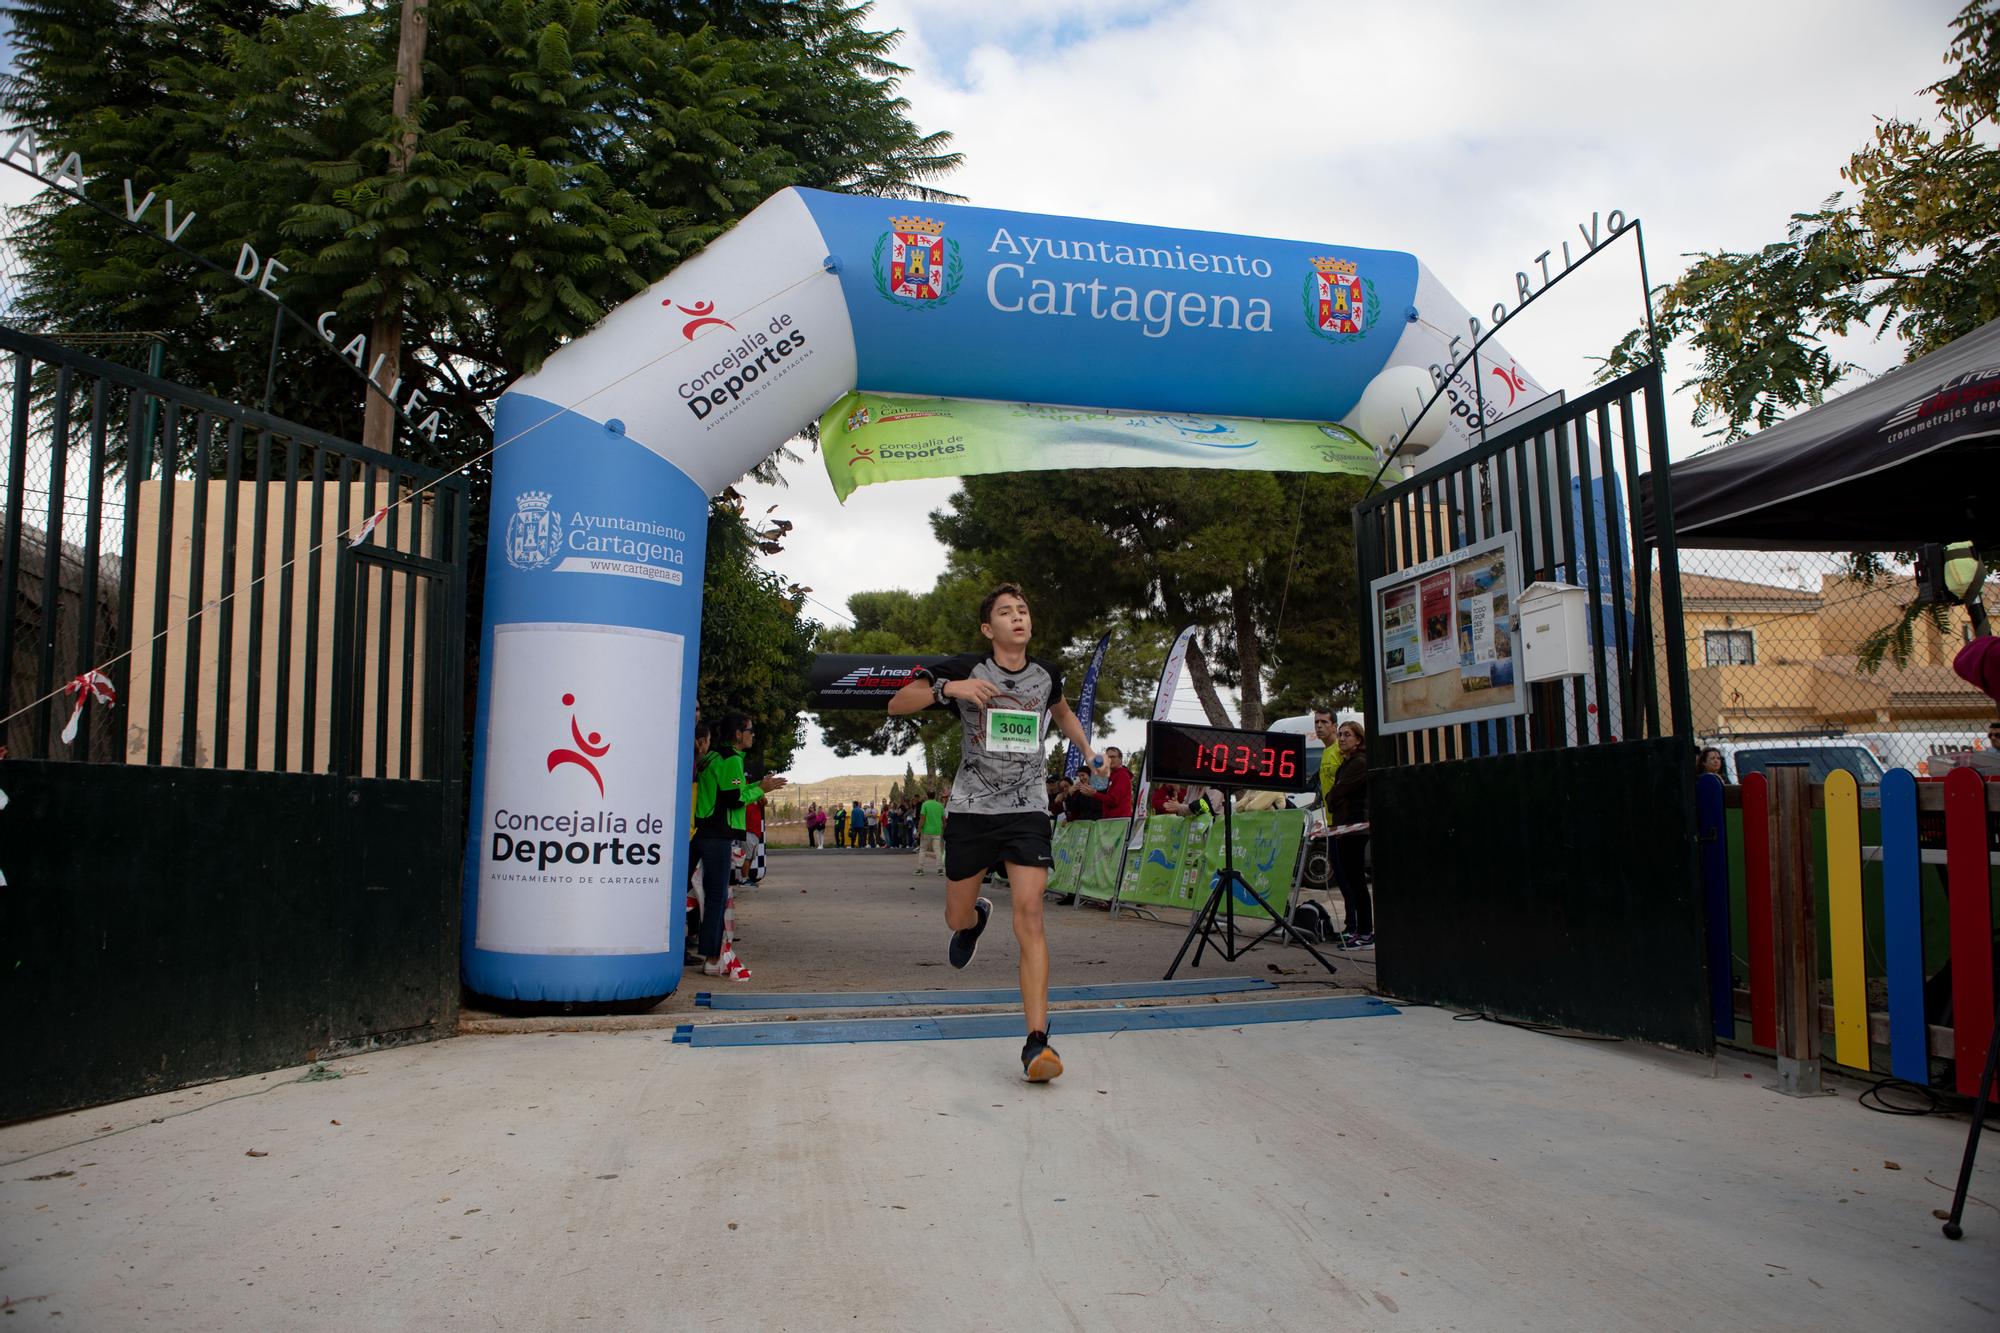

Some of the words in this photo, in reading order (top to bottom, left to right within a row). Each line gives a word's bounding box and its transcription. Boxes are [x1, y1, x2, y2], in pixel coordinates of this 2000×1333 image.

[987, 228, 1273, 278] Ayuntamiento
[987, 263, 1273, 338] Cartagena
[234, 243, 289, 300] DE
[317, 311, 441, 443] GALIFA
[678, 331, 768, 399] Concejalía
[769, 314, 793, 334] de
[687, 329, 806, 420] Deportes
[706, 390, 760, 432] AYUNTAMIENTO
[773, 349, 814, 381] CARTAGENA
[947, 435, 963, 443] de
[1887, 407, 1967, 443] cronometrajes
[880, 443, 965, 460] Deportes
[570, 512, 686, 542] Ayuntamiento
[568, 530, 684, 564] Cartagena
[590, 559, 681, 583] www.cartagena.es
[1000, 723, 1031, 735] 3004
[1196, 744, 1295, 779] 1:03:36
[495, 809, 627, 837] Concejalía
[636, 813, 662, 834] de
[492, 832, 661, 871] Deportes
[491, 873, 573, 884] AYUNTAMIENTO
[579, 876, 593, 884] DE
